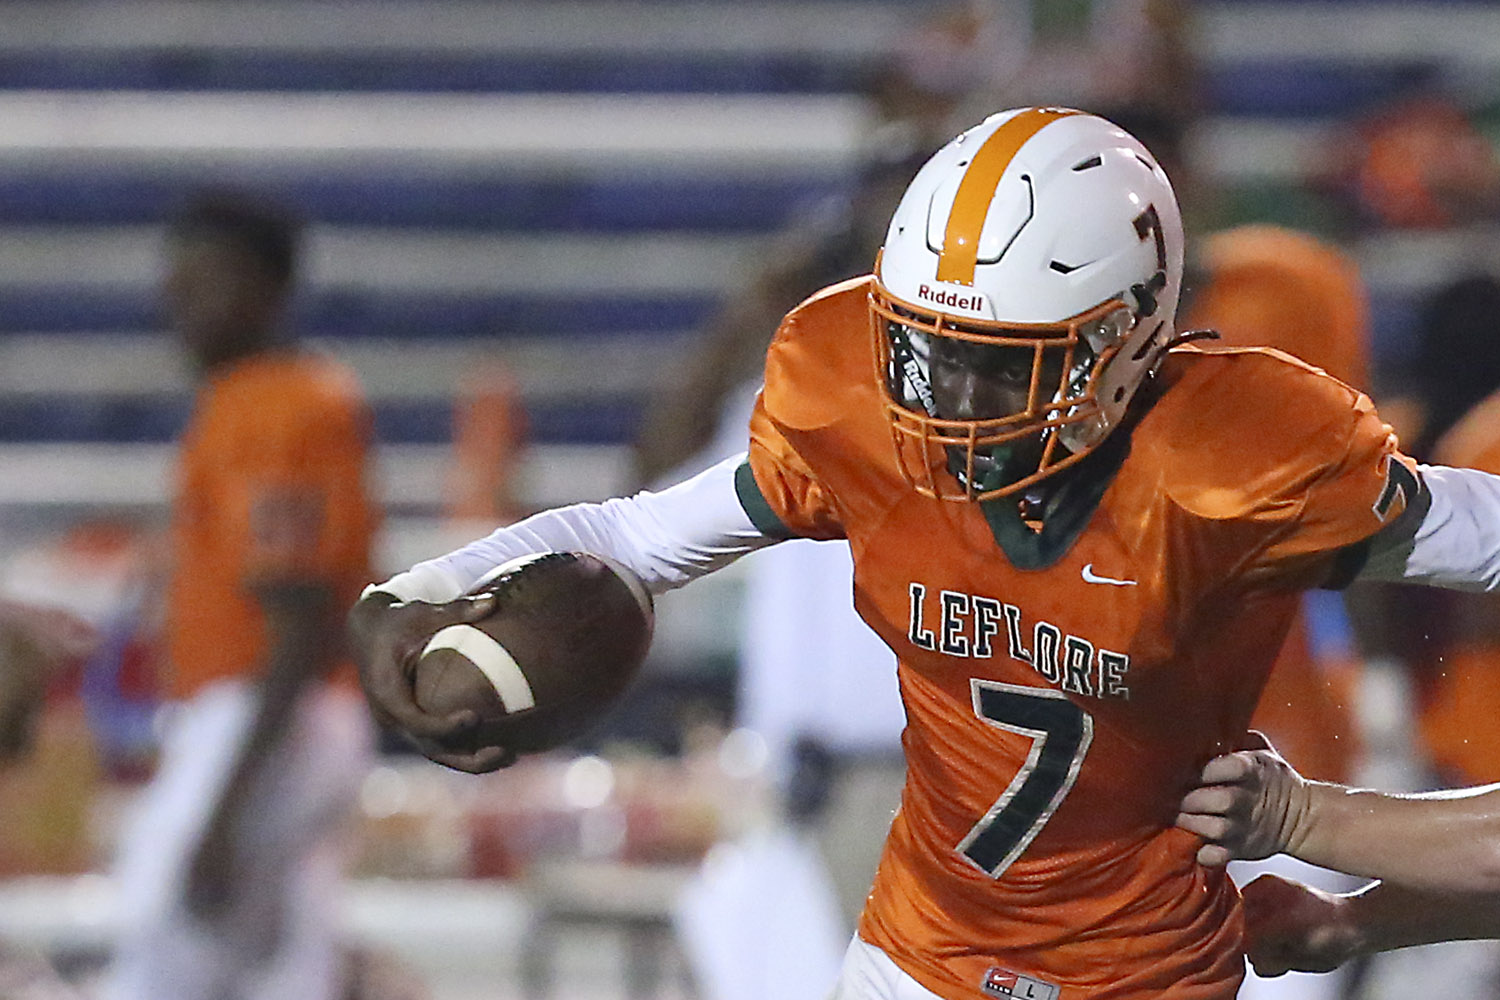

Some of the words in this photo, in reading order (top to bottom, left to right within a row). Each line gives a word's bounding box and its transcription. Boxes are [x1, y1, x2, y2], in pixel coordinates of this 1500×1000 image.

[918, 283, 984, 312] Riddell
[907, 582, 1132, 701] LEFLORE
[954, 677, 1094, 880] 7
[988, 982, 1011, 994] TEAM
[1026, 984, 1035, 999] L
